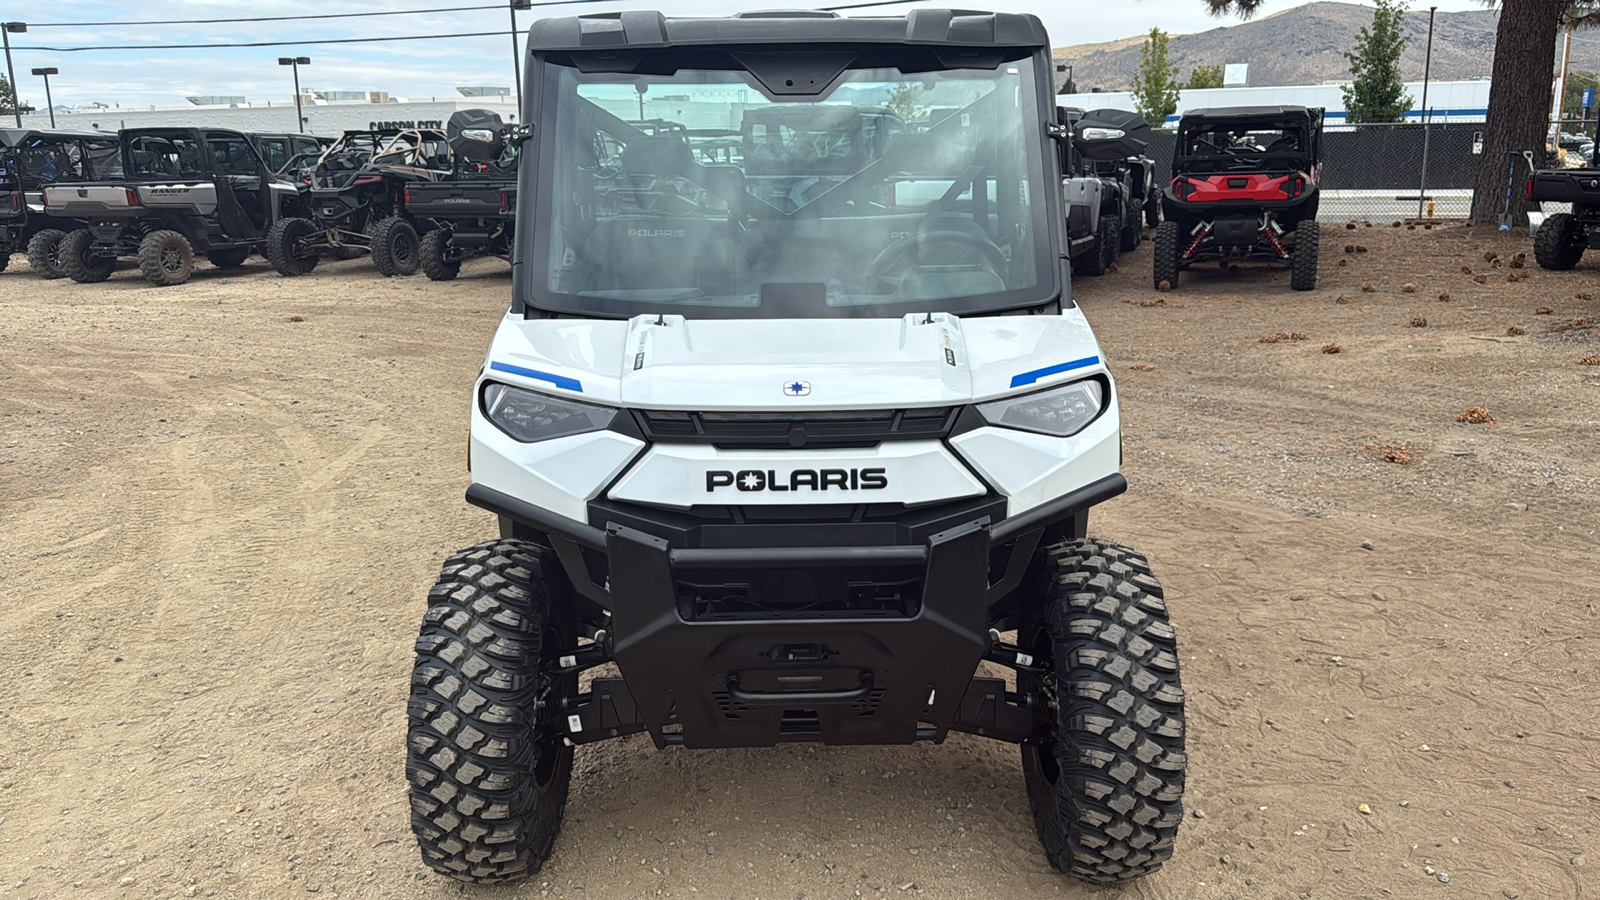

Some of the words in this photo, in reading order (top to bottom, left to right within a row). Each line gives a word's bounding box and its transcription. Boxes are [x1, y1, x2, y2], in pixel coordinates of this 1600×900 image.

[369, 121, 415, 130] CARSON
[417, 120, 442, 130] CITY
[628, 229, 685, 237] POLARIS
[706, 467, 888, 492] POLARIS
